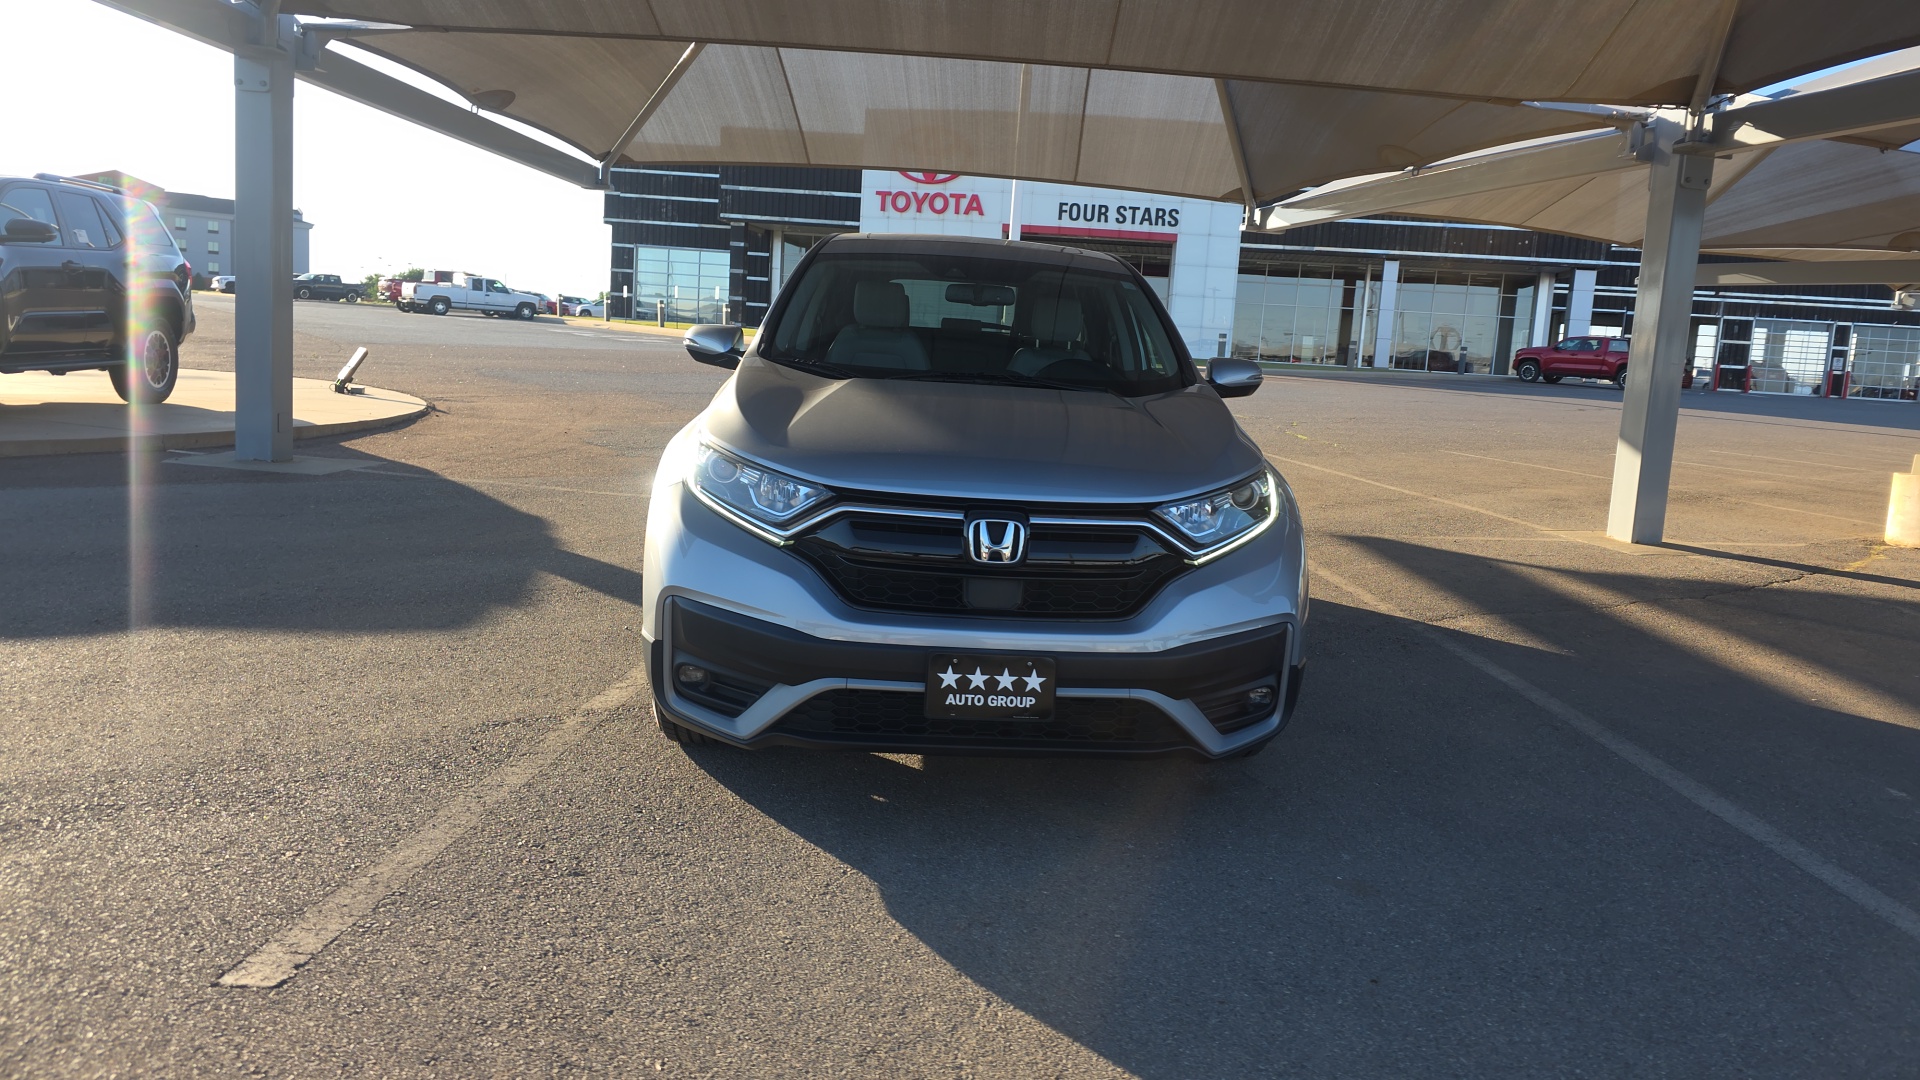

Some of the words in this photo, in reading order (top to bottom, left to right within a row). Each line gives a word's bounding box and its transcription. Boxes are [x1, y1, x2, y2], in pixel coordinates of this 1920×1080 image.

[875, 190, 985, 217] TOYOTA
[1057, 202, 1109, 224] FOUR
[1115, 205, 1180, 228] STARS
[945, 693, 985, 707] AUTO
[987, 695, 1036, 708] GROUP
